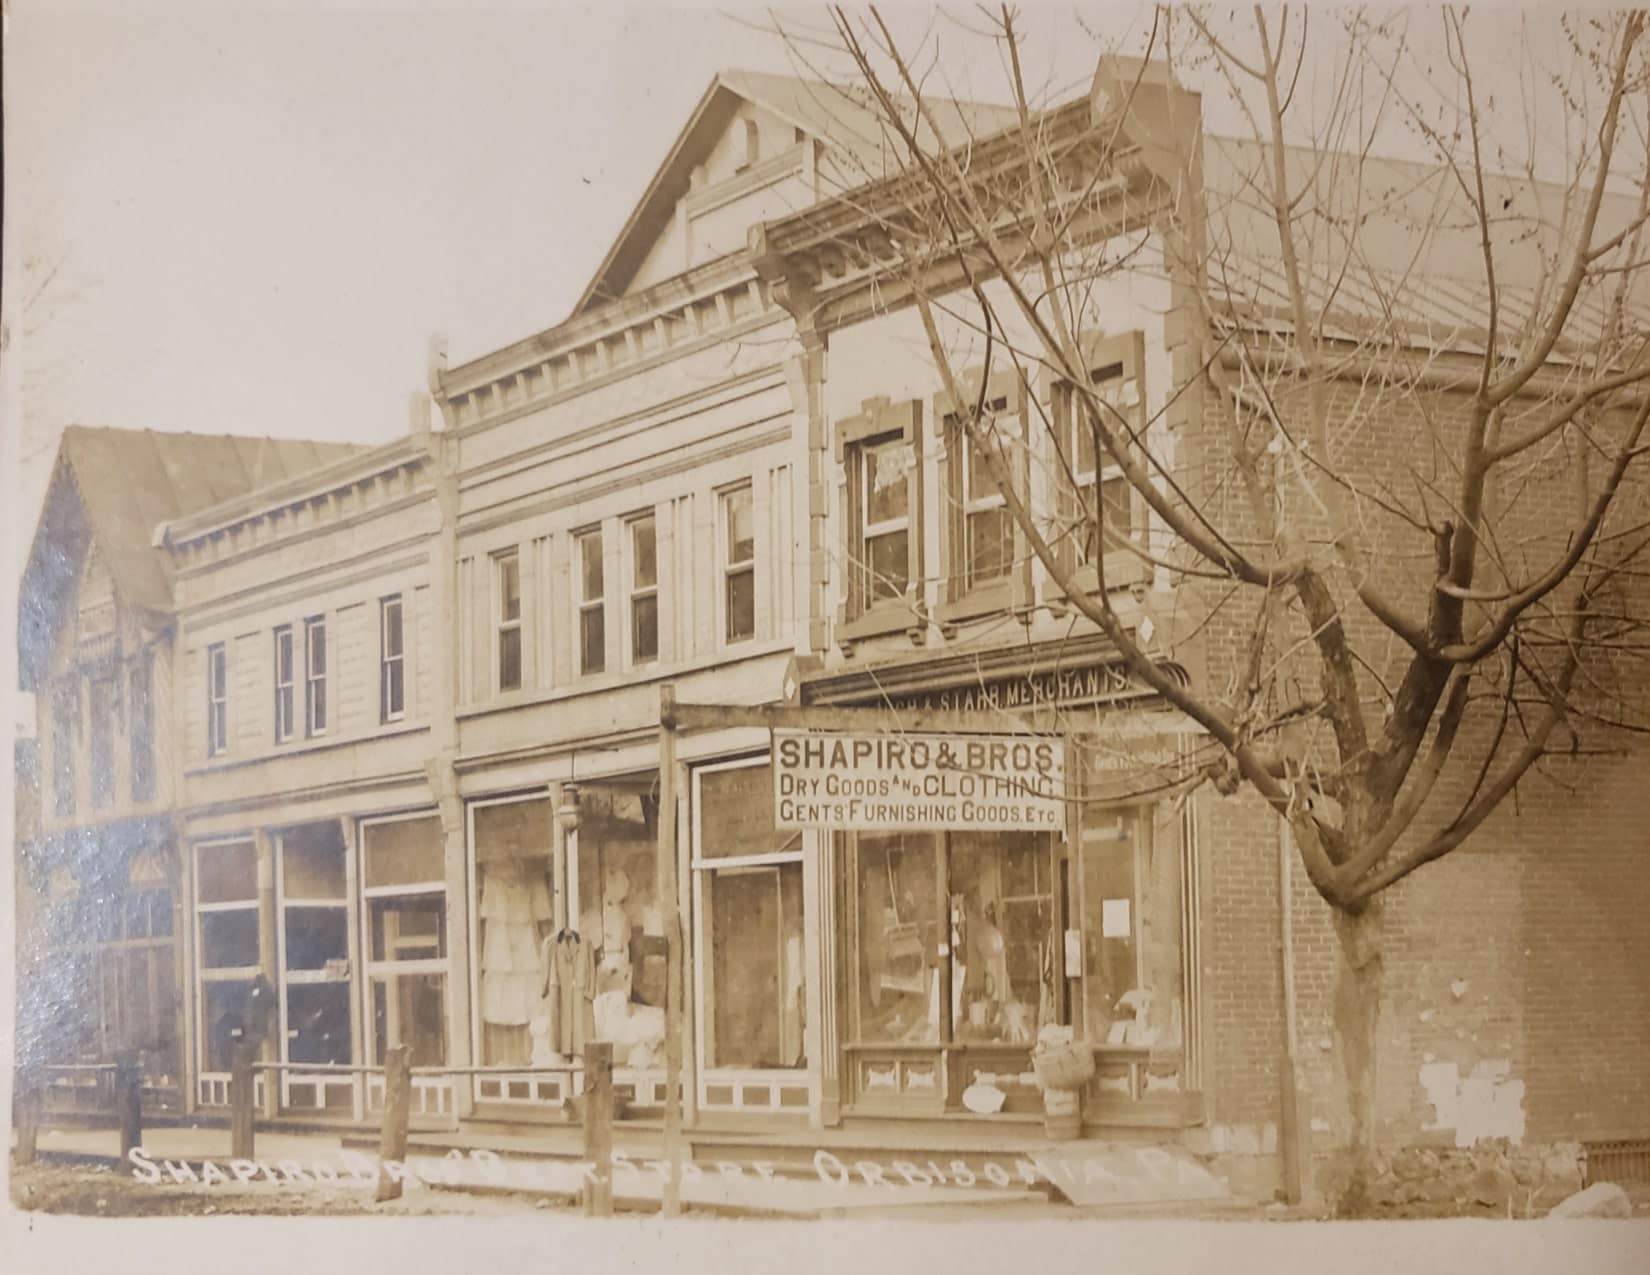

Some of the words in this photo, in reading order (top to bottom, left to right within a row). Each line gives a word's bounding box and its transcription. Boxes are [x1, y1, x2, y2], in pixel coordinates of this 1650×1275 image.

[780, 739, 930, 770] SHAPIRO
[935, 742, 962, 770] &
[966, 743, 1063, 772] BROS.
[780, 774, 820, 797] DRY
[826, 774, 889, 797] GOODS
[893, 774, 921, 797] AND
[924, 775, 1054, 799] CLOTHING
[850, 799, 957, 822] FURNISHING
